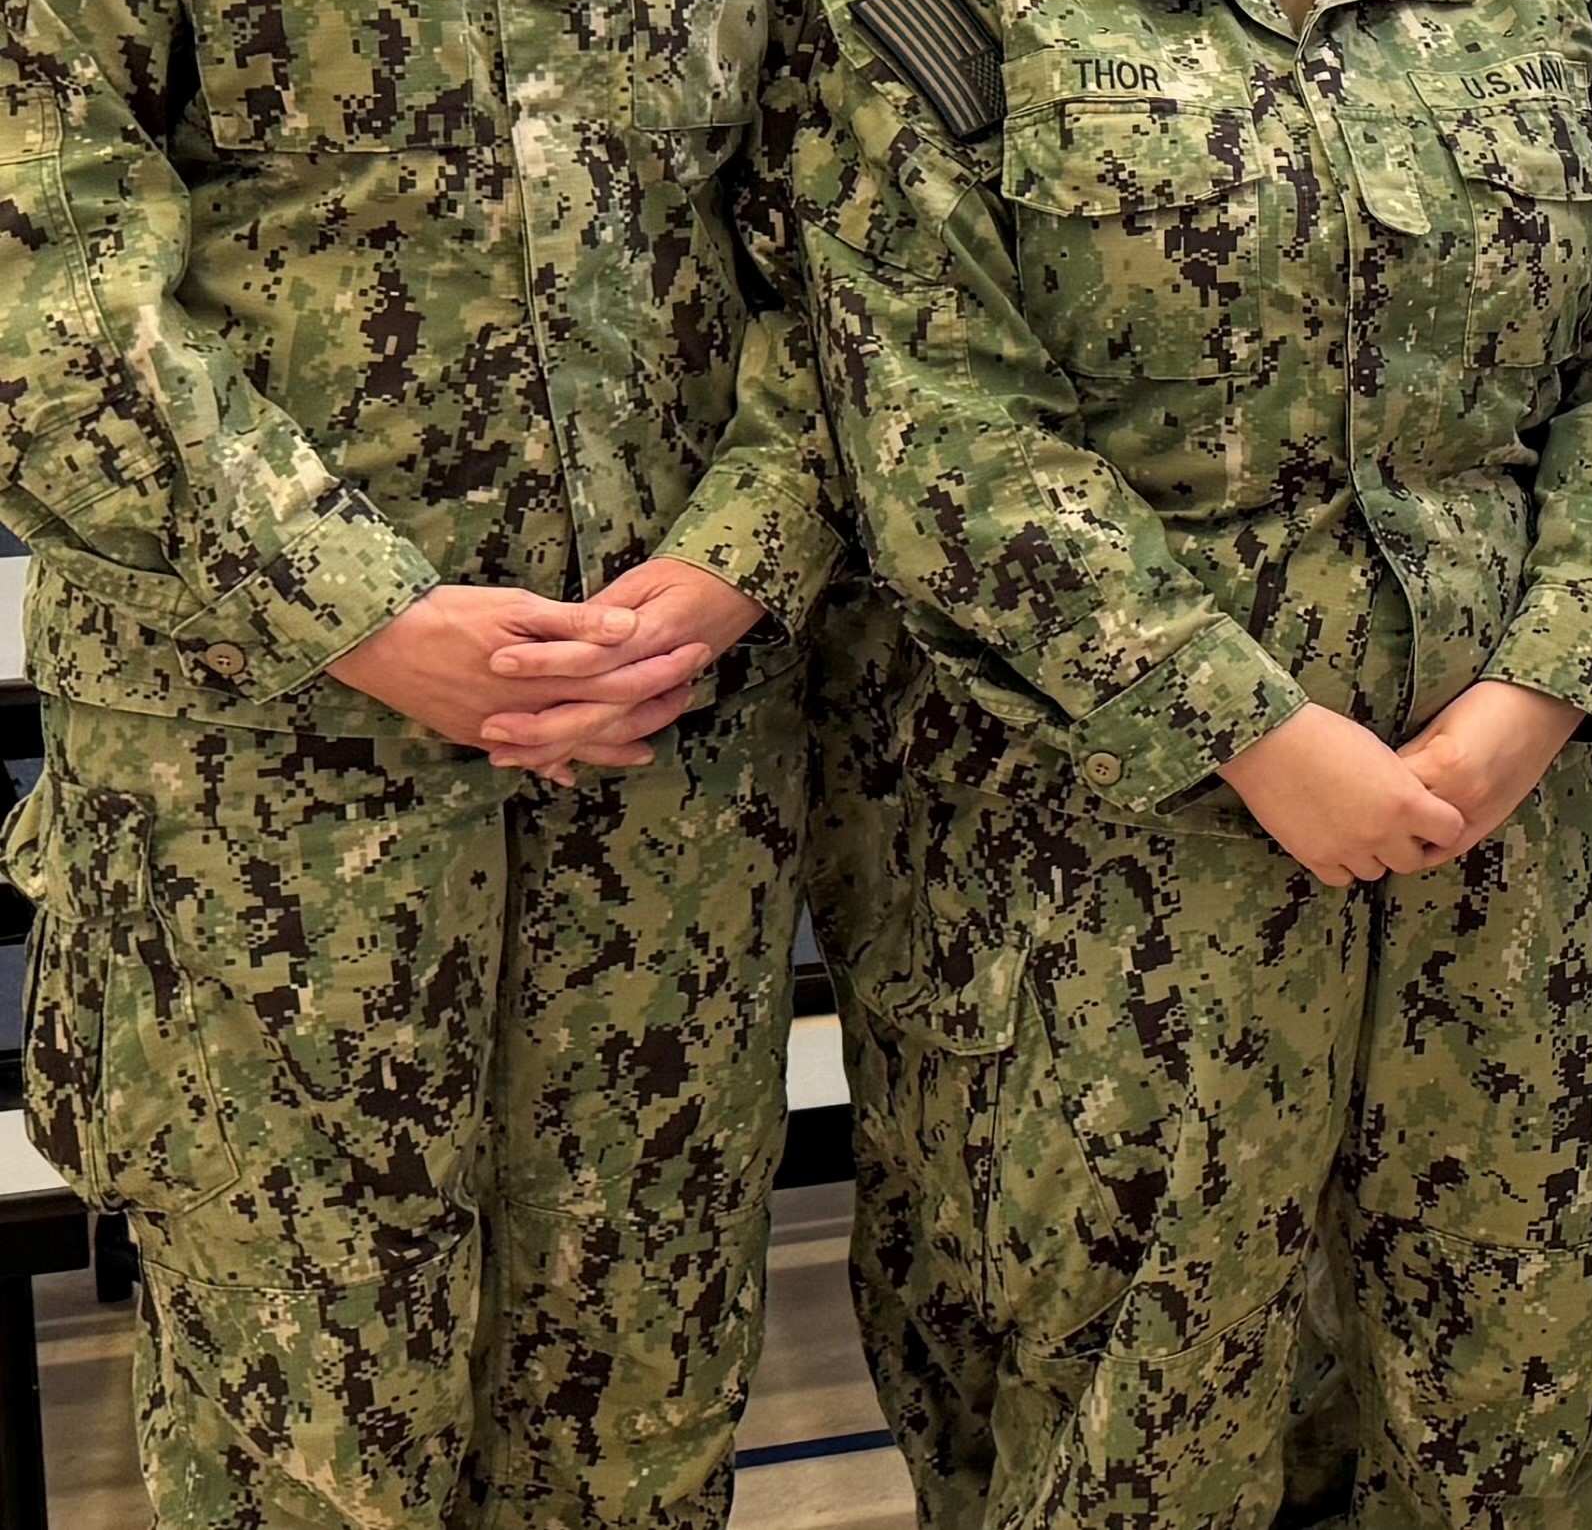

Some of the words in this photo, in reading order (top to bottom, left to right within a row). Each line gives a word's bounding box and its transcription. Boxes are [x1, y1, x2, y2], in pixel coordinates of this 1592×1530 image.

[1072, 58, 1162, 92] THOR
[1460, 71, 1519, 100] U.S.
[1514, 59, 1564, 91] NAV
